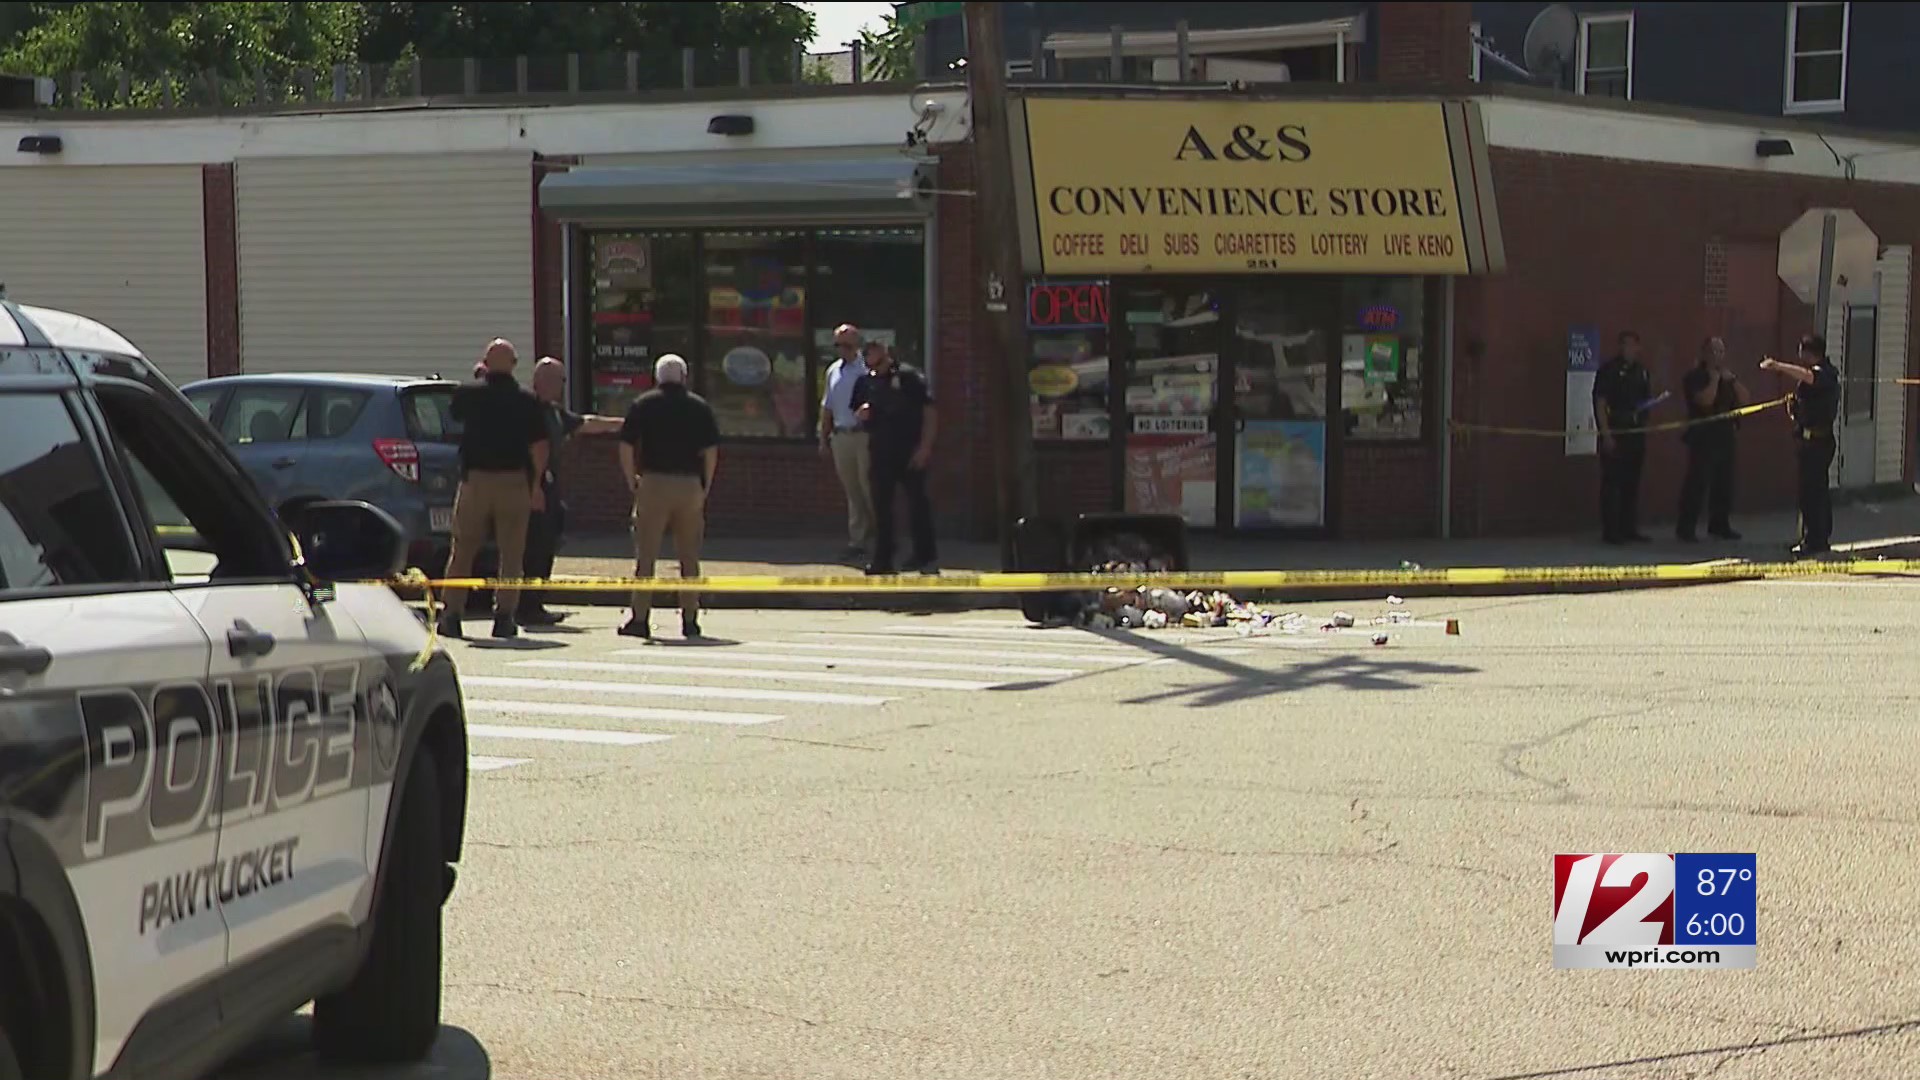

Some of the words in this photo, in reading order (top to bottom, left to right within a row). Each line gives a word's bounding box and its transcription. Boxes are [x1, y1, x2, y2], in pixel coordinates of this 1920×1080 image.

[1174, 124, 1312, 163] A&S
[1049, 185, 1318, 217] CONVENIENCE
[1330, 187, 1447, 217] STORE
[1053, 233, 1104, 257] COFFEE
[1120, 233, 1149, 257] DELI
[1164, 233, 1199, 257] SUBS
[1214, 233, 1296, 257] CIGARETTES
[1311, 233, 1368, 257] LOTTERY
[1384, 233, 1411, 257] LIVE
[1418, 233, 1454, 257] KENO
[1247, 259, 1278, 270] 251
[1030, 284, 1110, 325] OPEN
[1138, 419, 1151, 430] NO
[1155, 419, 1204, 430] LOITERING
[77, 663, 360, 857] POLICE
[140, 837, 300, 935] PAWTUCKET
